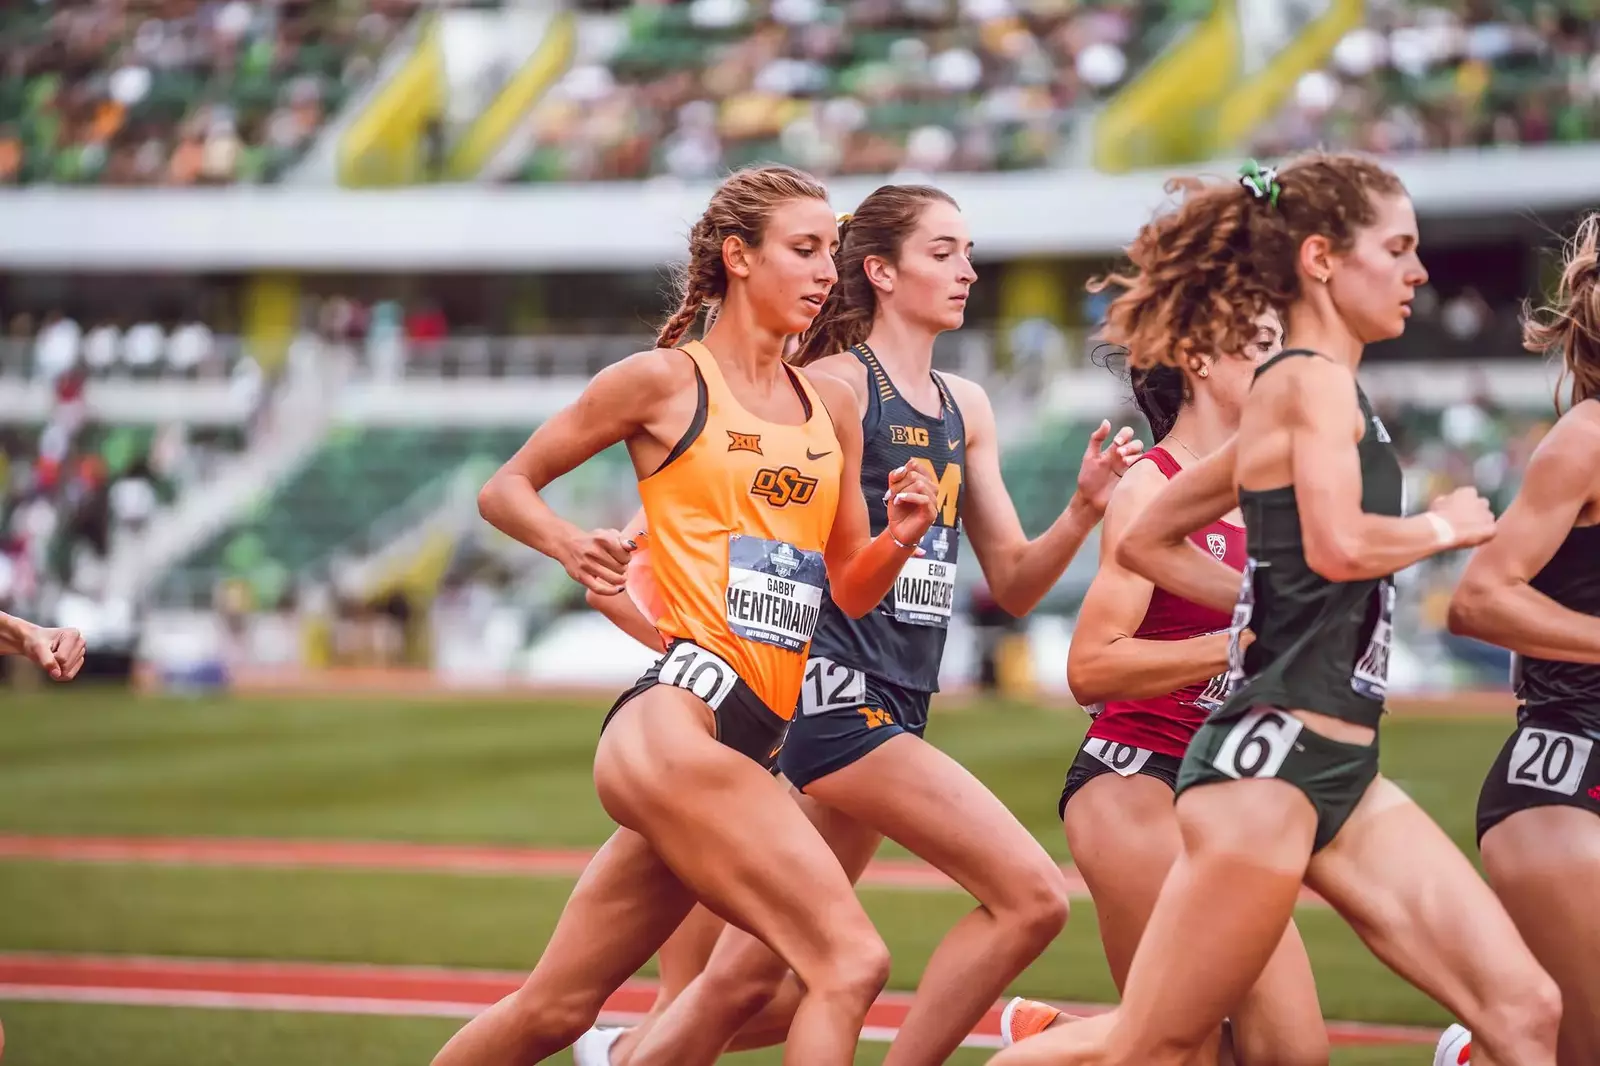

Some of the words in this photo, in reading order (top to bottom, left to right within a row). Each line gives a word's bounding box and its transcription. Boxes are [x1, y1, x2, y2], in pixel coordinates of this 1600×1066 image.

[750, 466, 819, 507] OSU
[727, 587, 819, 638] HENTEMANN
[767, 578, 796, 598] GABBY
[673, 651, 725, 704] 10
[805, 662, 856, 707] 12
[1233, 712, 1286, 778] 6
[1515, 732, 1574, 786] 20
